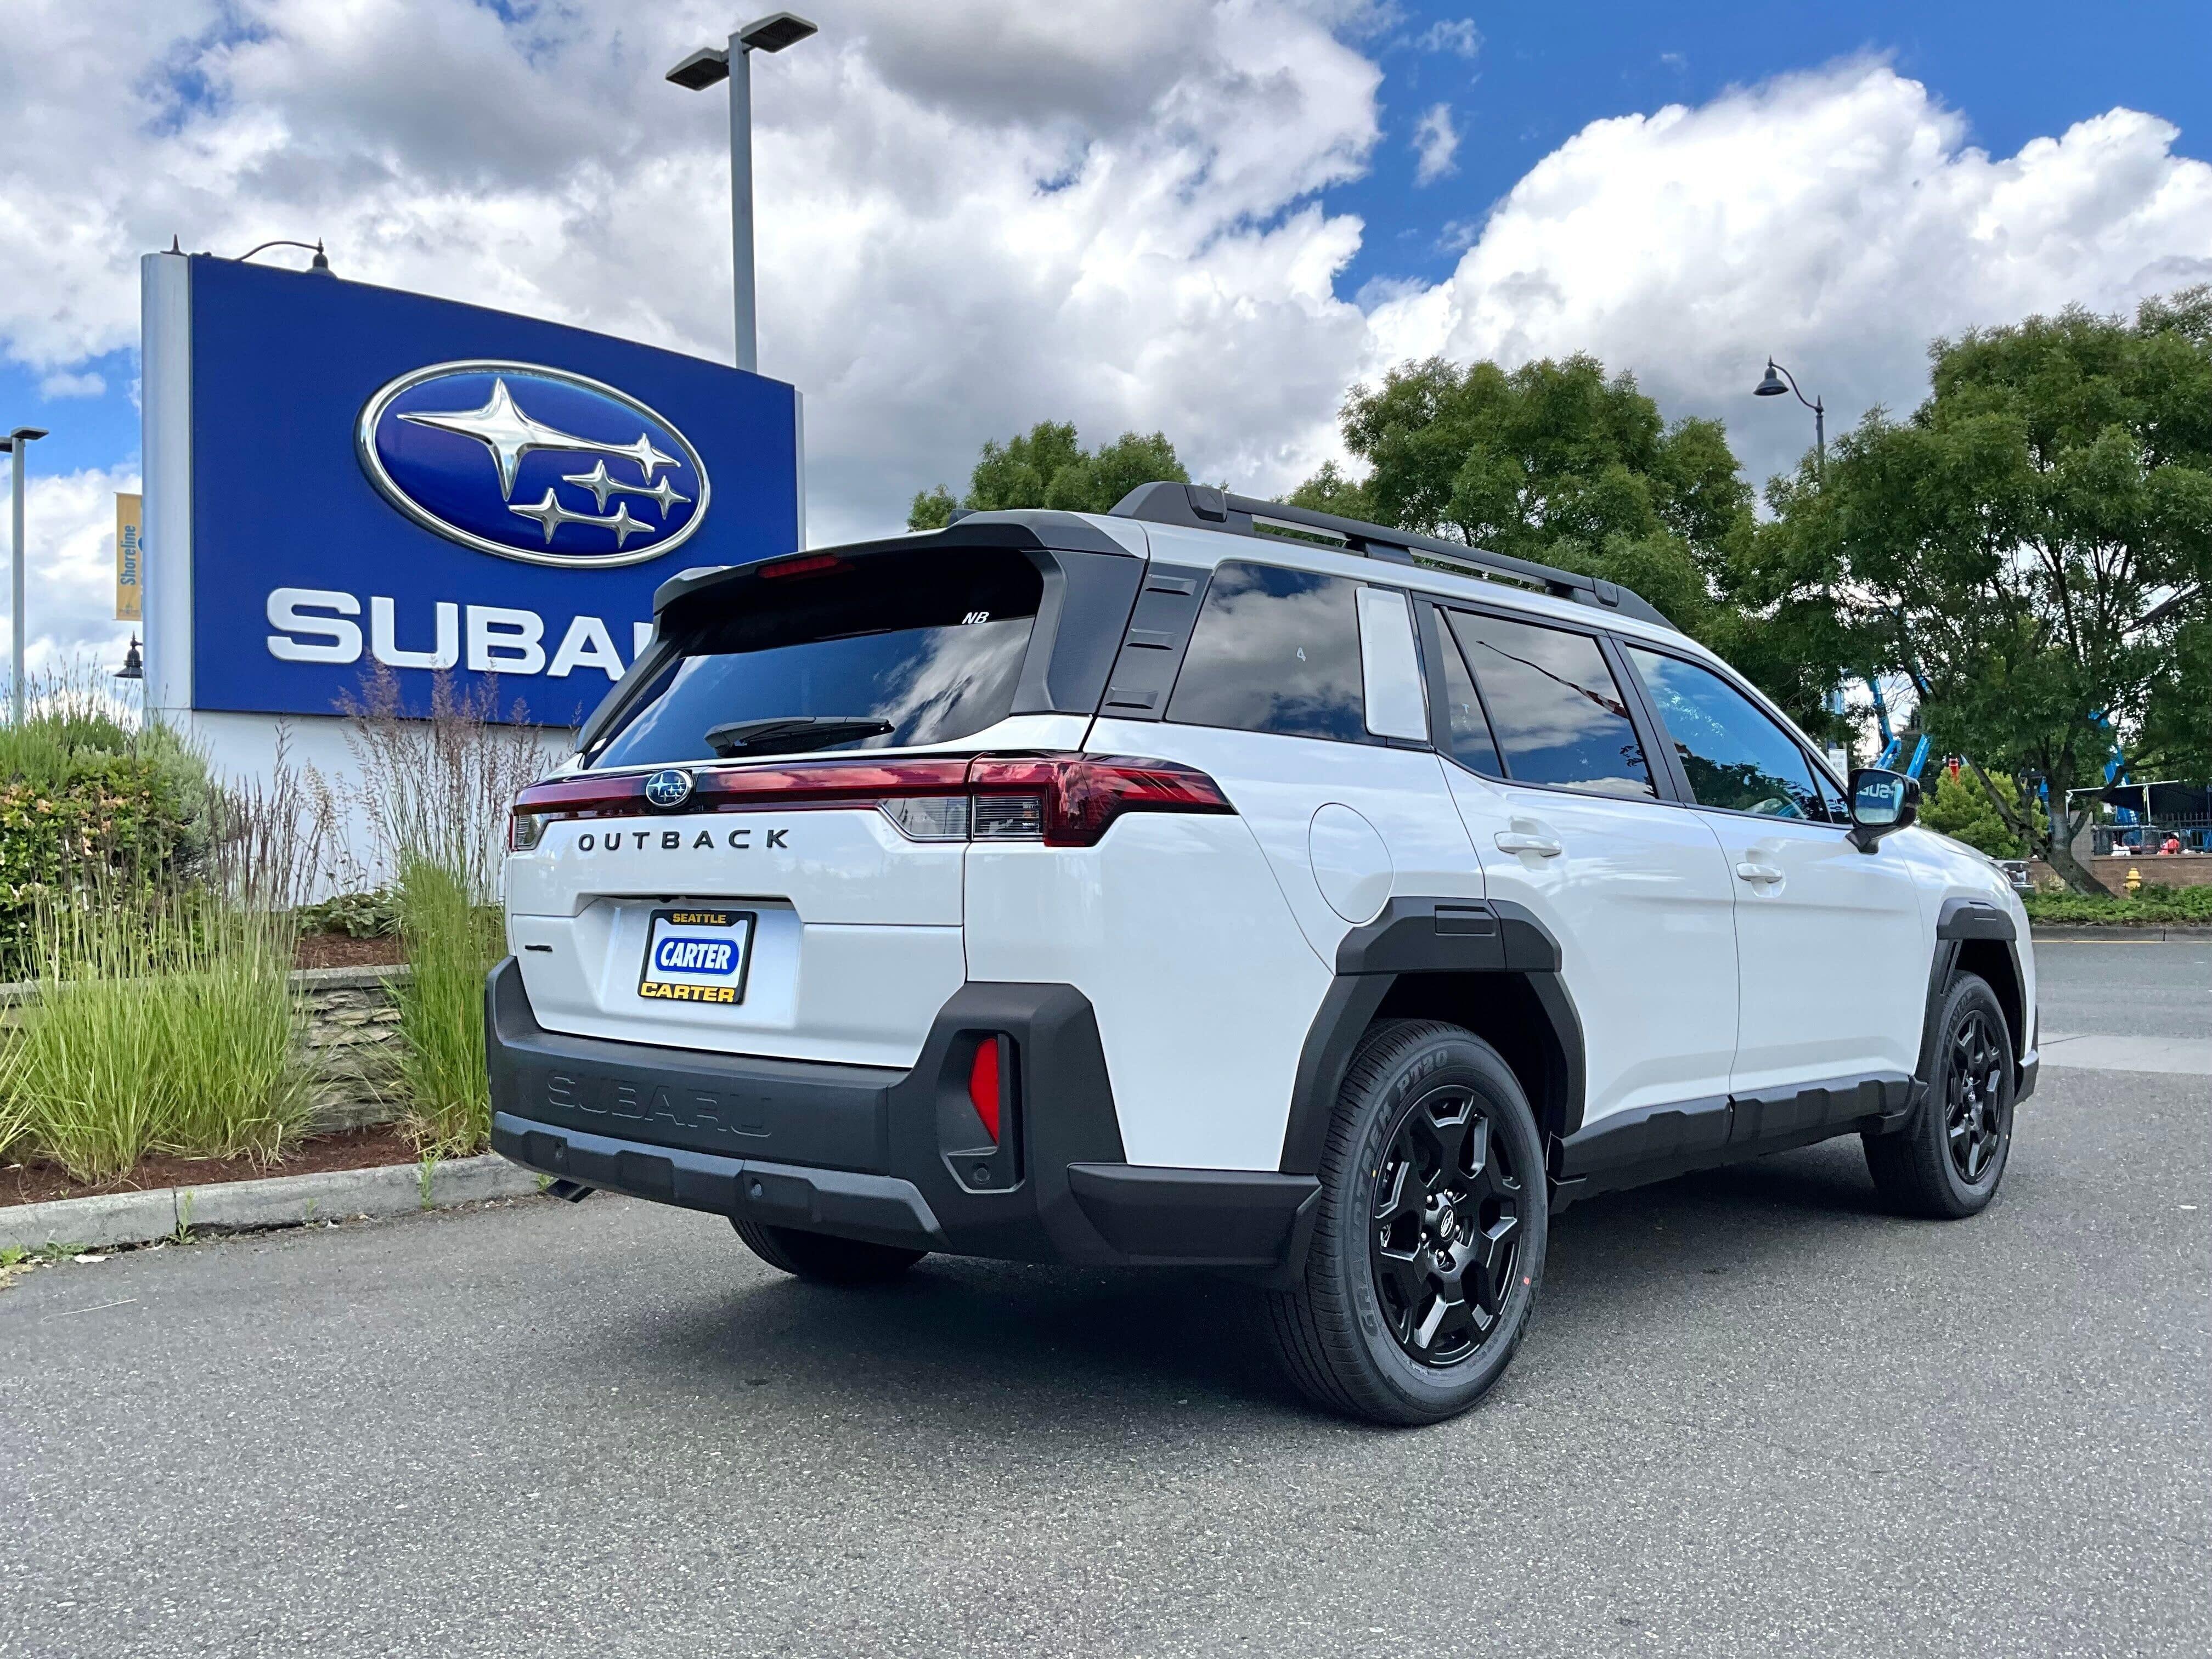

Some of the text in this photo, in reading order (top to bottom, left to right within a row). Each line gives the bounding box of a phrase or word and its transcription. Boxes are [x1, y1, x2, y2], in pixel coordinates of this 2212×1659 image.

[120, 524, 136, 586] Shoreline
[961, 612, 990, 624] NB
[267, 587, 654, 681] SUBA
[578, 830, 789, 851] OUTBACK
[673, 913, 726, 924] SEATTLE
[660, 941, 732, 970] CARTER
[640, 982, 735, 1003] CARTER
[548, 1069, 772, 1138] SUBARU
